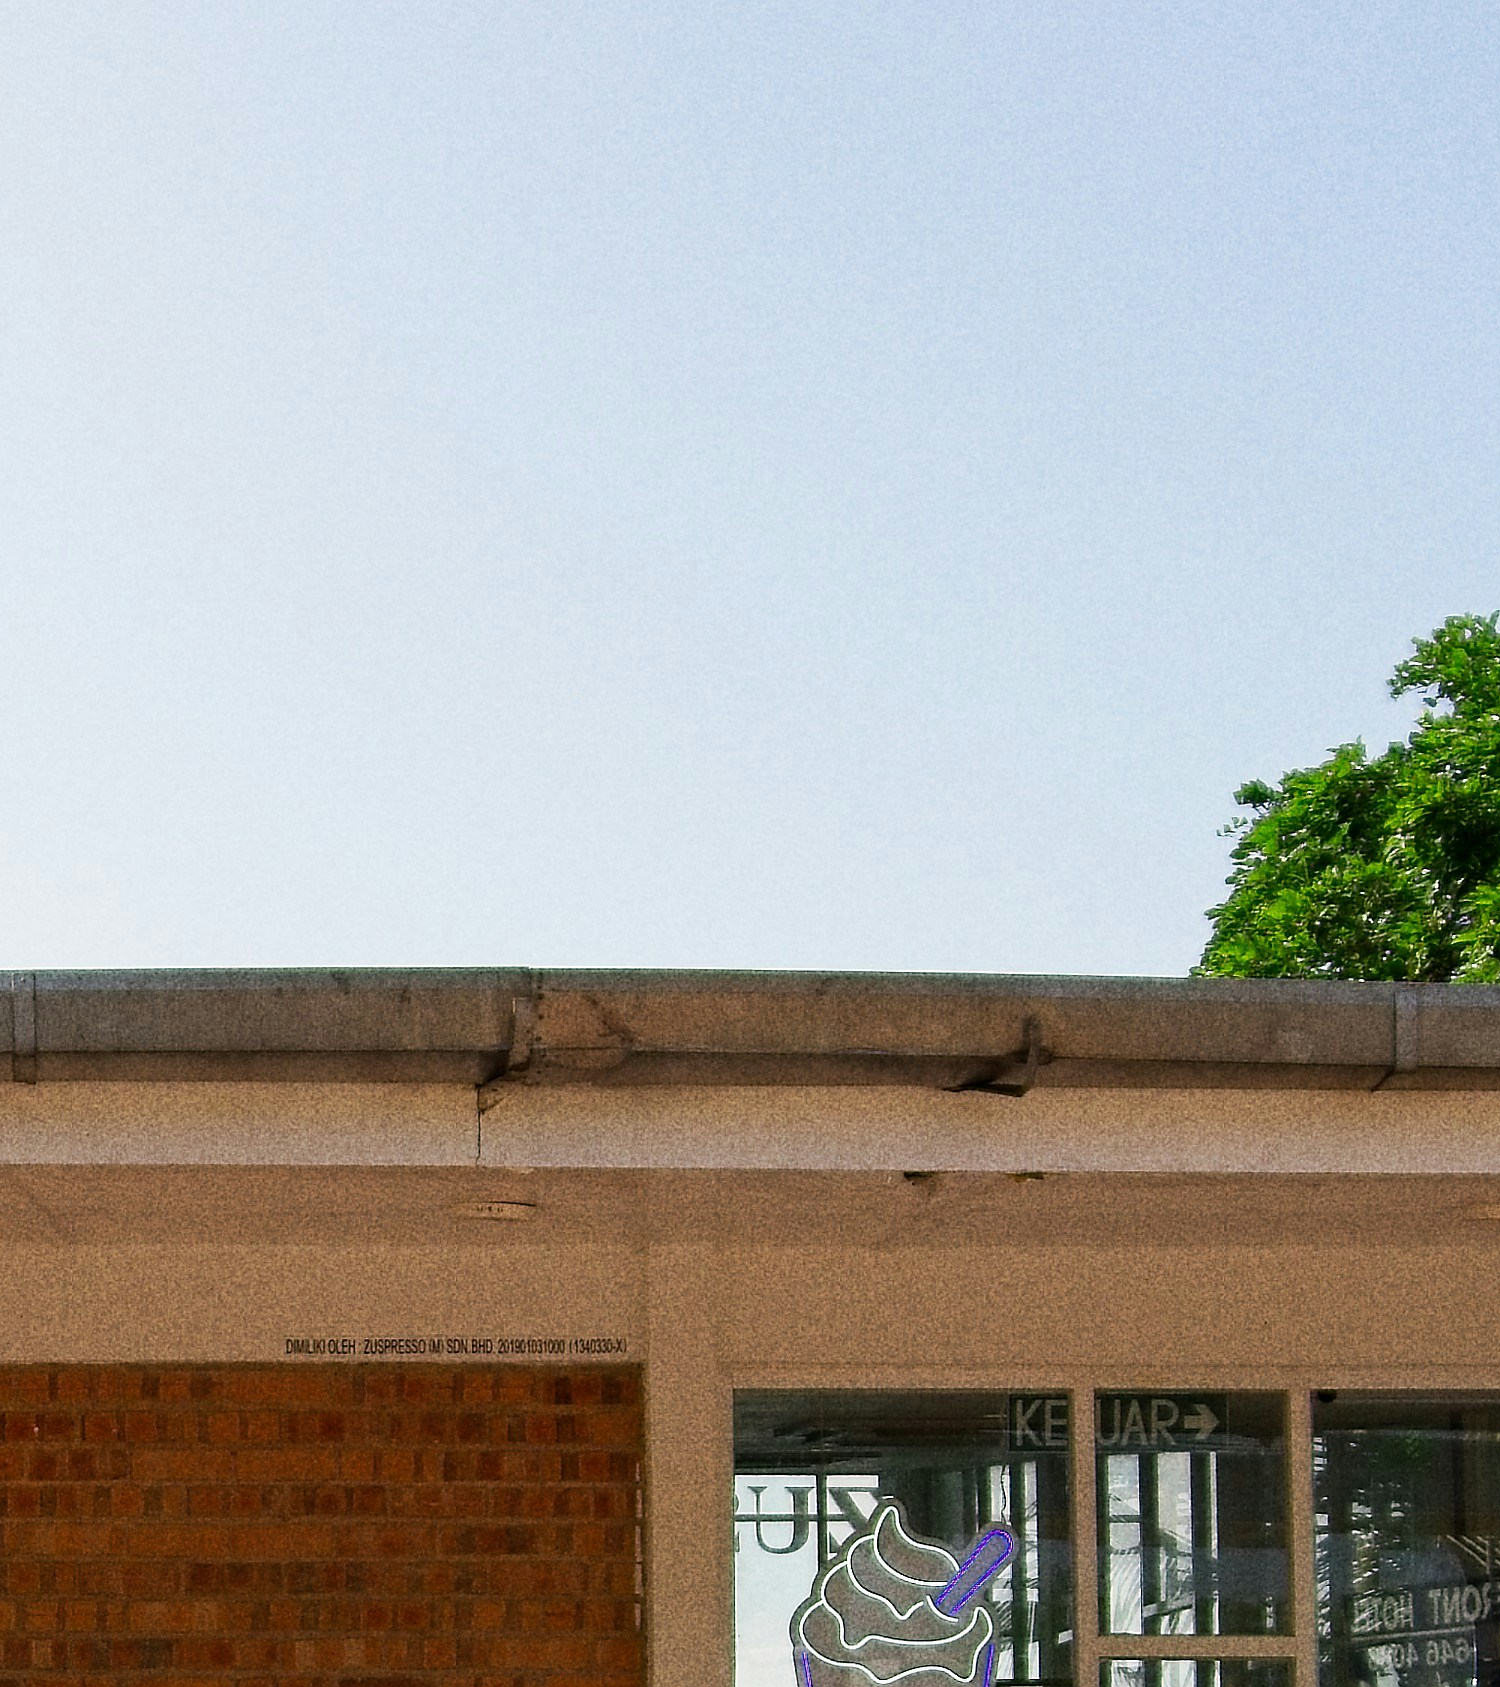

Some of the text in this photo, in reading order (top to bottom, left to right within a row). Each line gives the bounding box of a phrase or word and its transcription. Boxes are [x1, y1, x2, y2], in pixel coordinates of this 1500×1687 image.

[285, 1339, 325, 1354] DIMILIKI
[327, 1339, 356, 1354] OLEH
[363, 1339, 426, 1354] ZUSPRESSO
[428, 1338, 445, 1354] (M)
[1015, 1398, 1177, 1447] KEUAR
